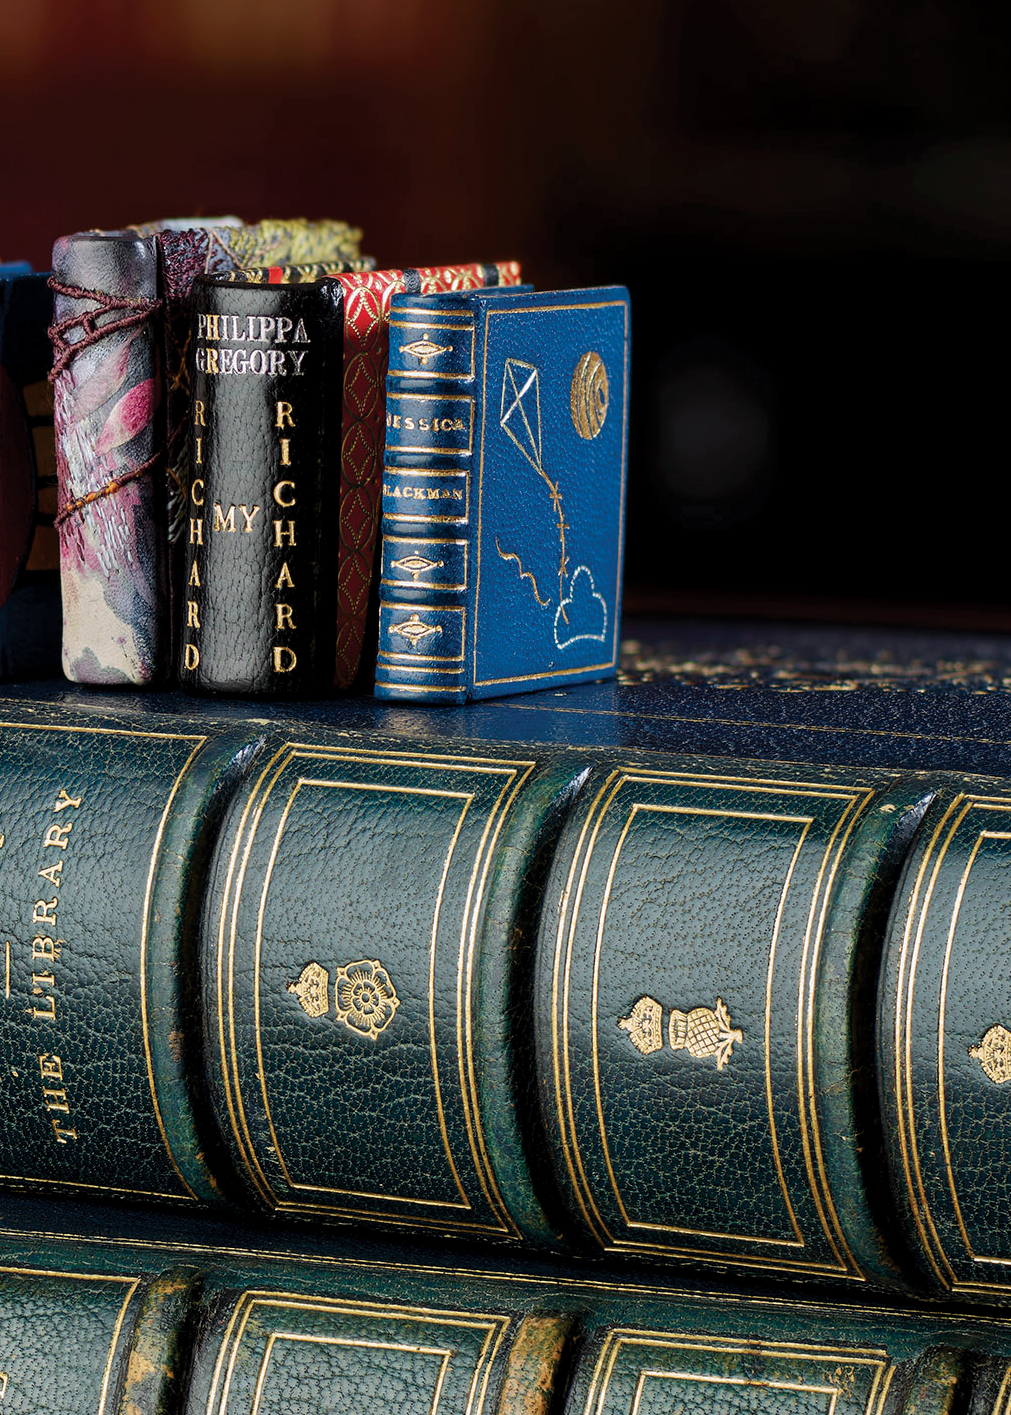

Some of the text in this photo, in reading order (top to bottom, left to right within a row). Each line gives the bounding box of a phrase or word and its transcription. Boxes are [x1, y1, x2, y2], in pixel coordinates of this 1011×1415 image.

[195, 347, 308, 376] GREGORY
[197, 313, 311, 343] PHILIPPA
[185, 399, 206, 671] RICHARD
[213, 502, 260, 533] MY
[273, 400, 297, 673] RICHARD
[32, 789, 83, 1145] THE LIBRARY
